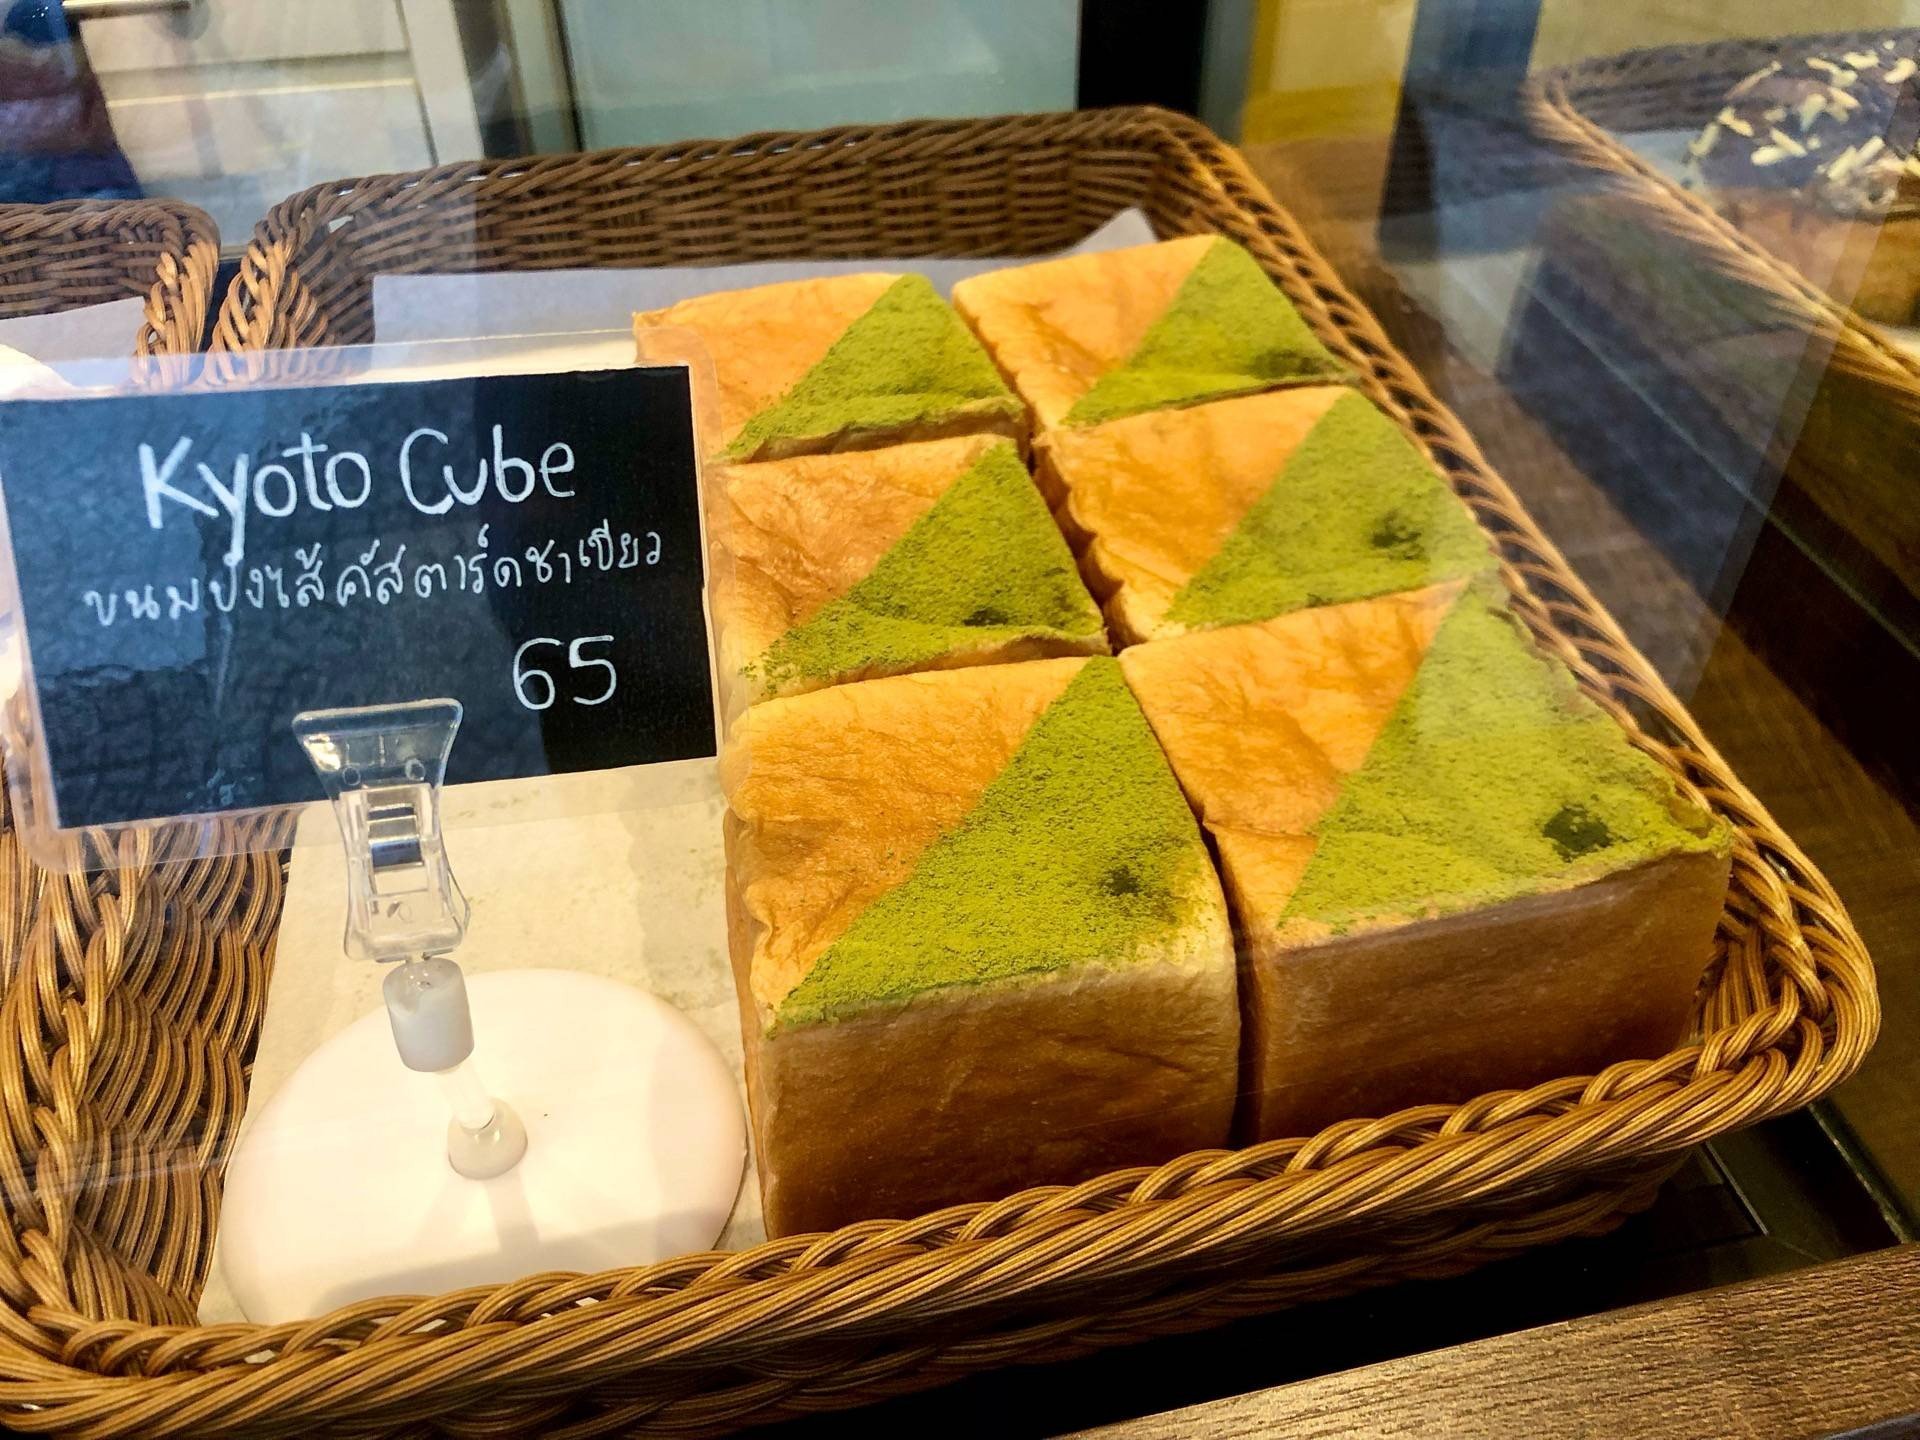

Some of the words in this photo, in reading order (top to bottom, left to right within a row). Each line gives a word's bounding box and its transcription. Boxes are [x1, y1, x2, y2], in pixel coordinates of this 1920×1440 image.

[139, 432, 372, 561] Kyoto
[399, 425, 576, 515] Cube
[512, 635, 617, 710] 65
